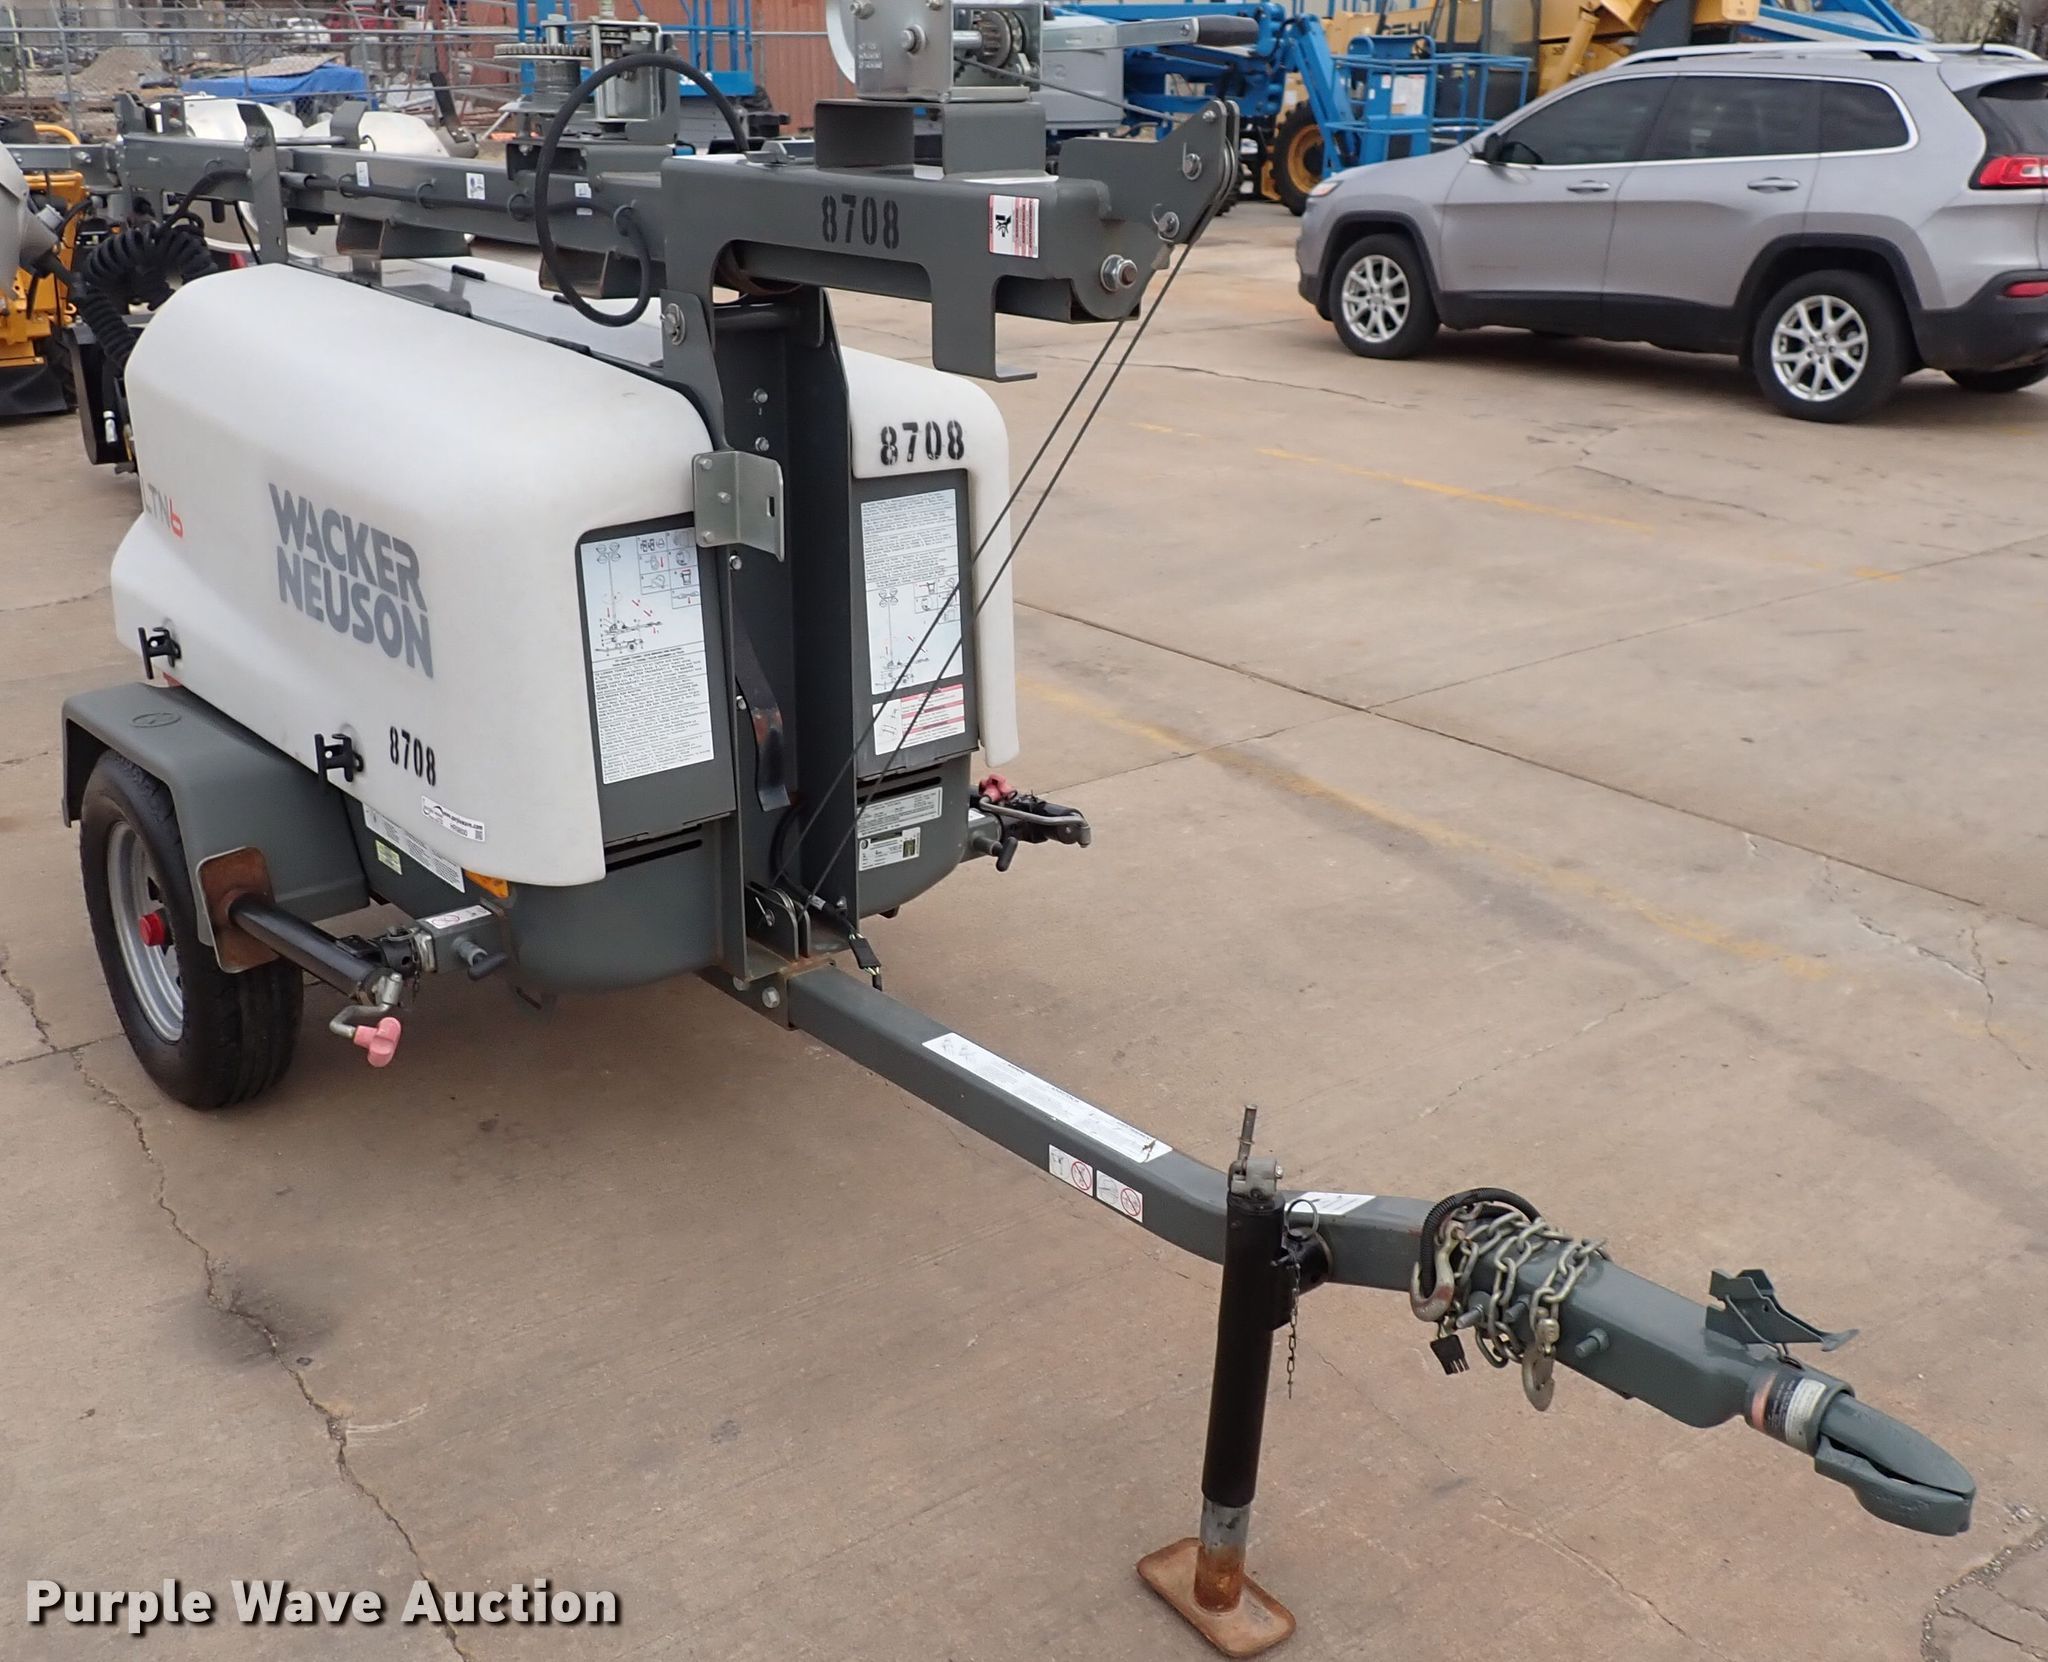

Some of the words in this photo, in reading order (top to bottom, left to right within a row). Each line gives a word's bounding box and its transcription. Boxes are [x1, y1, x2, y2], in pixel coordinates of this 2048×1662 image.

[821, 193, 900, 250] 8708
[880, 420, 965, 467] 8708
[268, 482, 428, 614] WACKER
[277, 544, 434, 680] NEUSON
[389, 725, 437, 787] 8708
